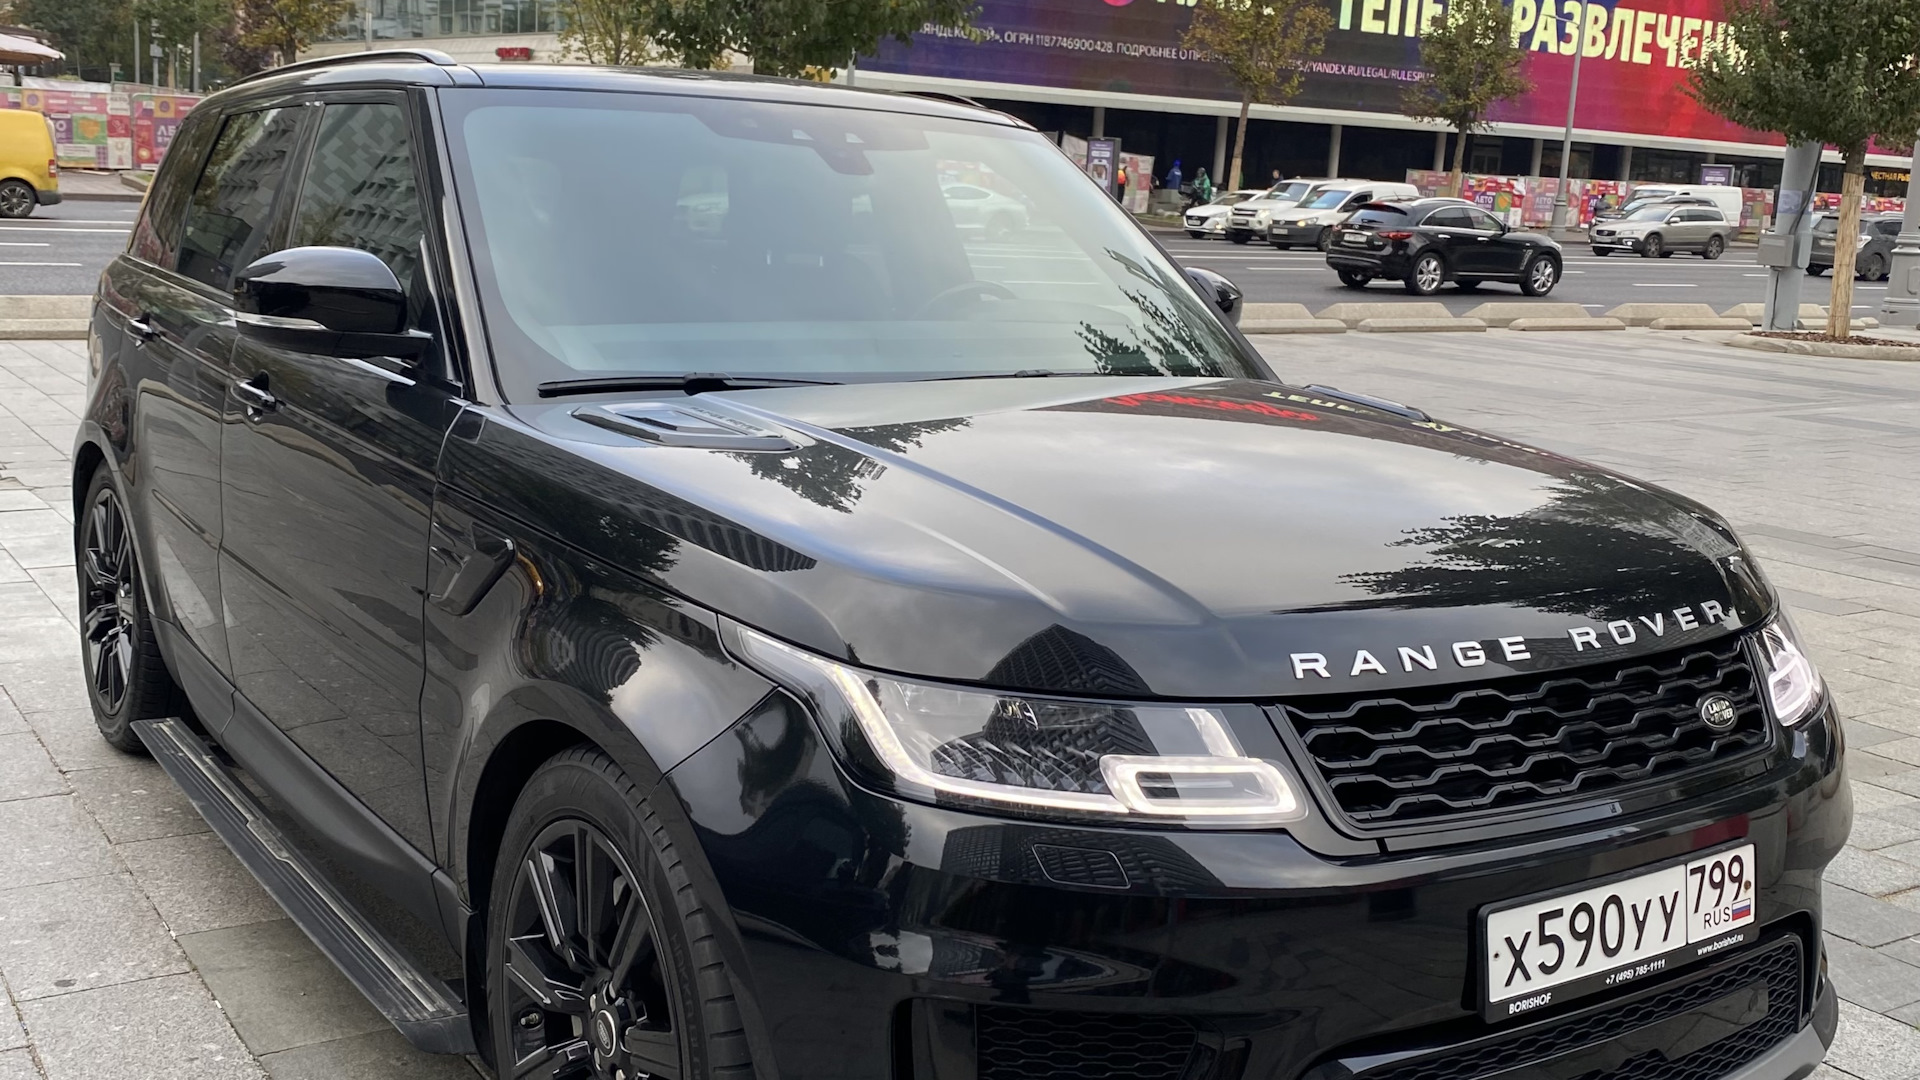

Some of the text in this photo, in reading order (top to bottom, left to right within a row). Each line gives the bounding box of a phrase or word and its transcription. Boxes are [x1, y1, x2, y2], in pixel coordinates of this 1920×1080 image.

[1004, 31, 1034, 44] ОГРН
[1116, 42, 1178, 60] ПОДРОБНЕЕ
[1475, 195, 1493, 204] ЛЕТО
[1289, 600, 1727, 680] RANGE ROVER
[1707, 700, 1727, 715] LAND
[1689, 854, 1745, 914] 799
[1703, 906, 1731, 930] RUS
[1697, 933, 1744, 956] www.borishof.ru
[1605, 958, 1666, 985] +7 (495) 785-1111
[1508, 992, 1552, 1015] BORISHOF
